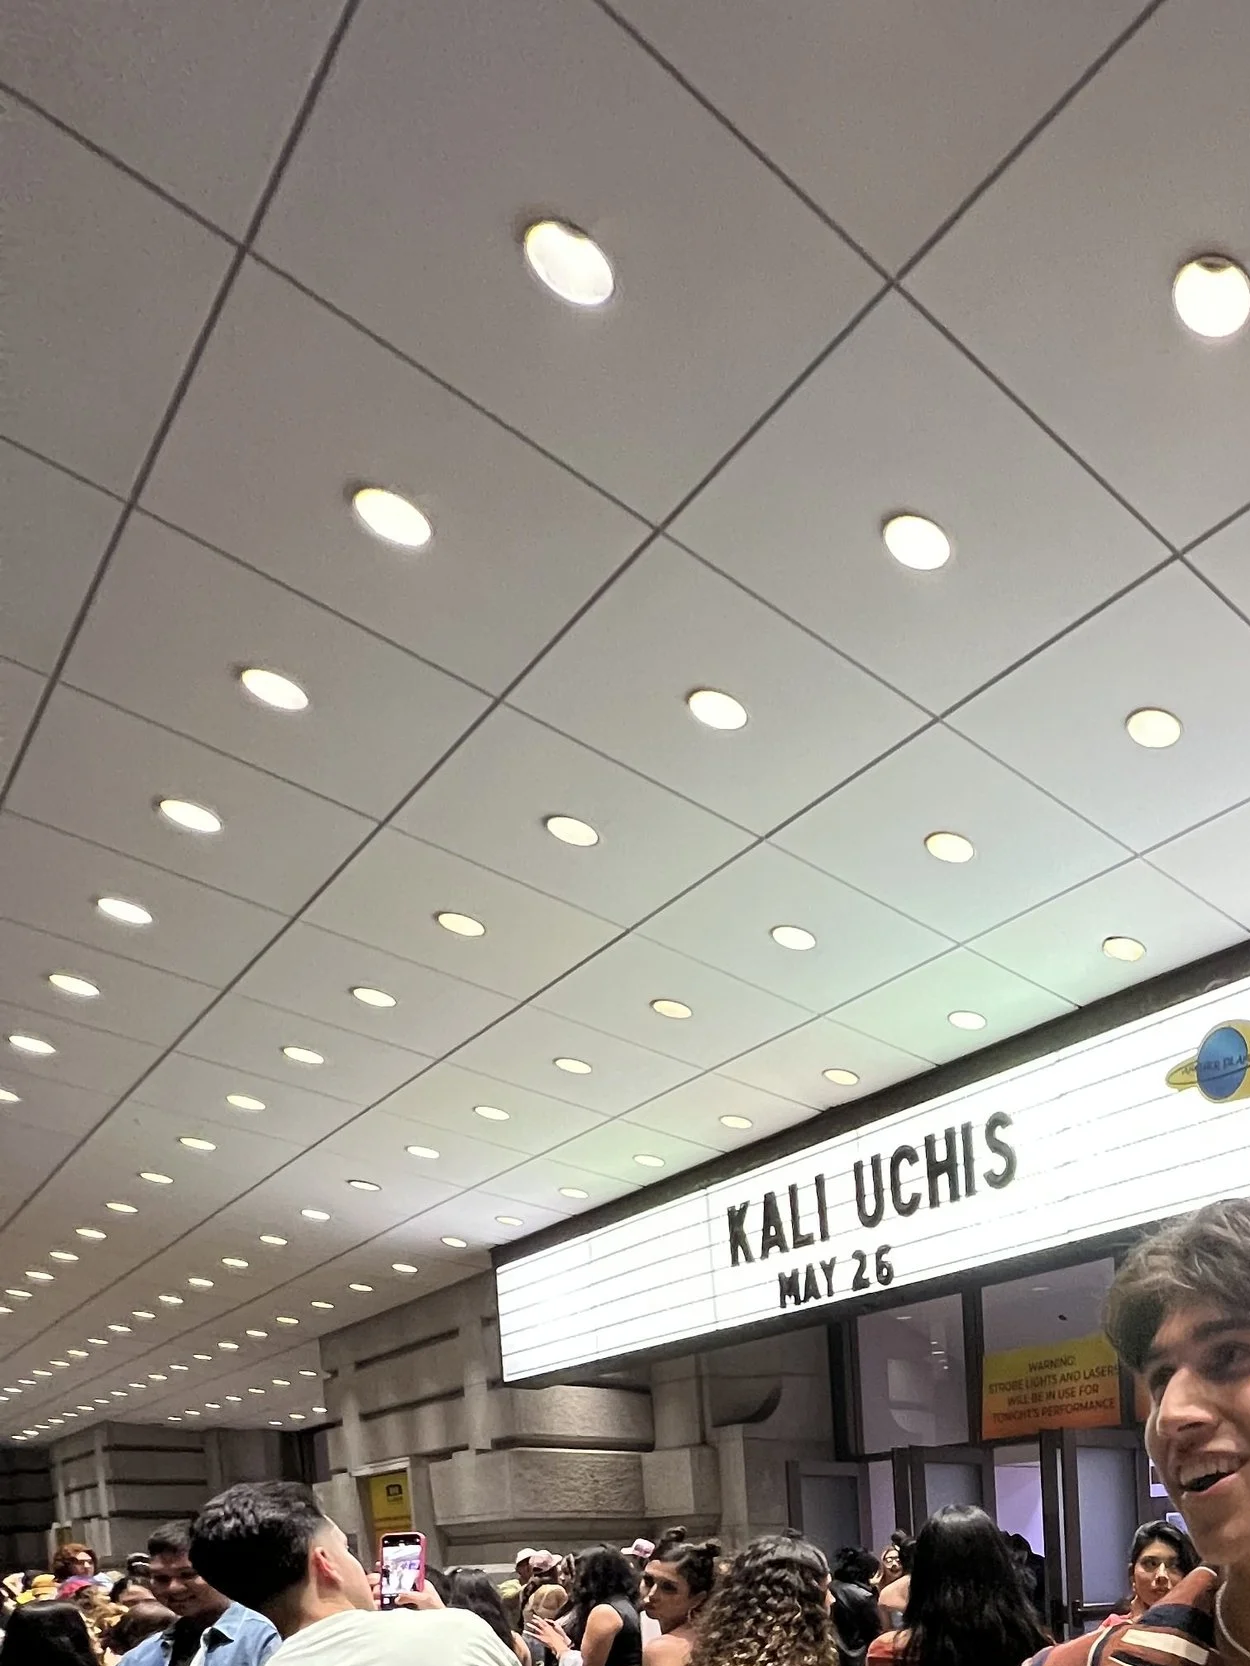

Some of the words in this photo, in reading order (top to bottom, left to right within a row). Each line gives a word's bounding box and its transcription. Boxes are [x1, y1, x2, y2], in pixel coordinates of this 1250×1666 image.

[727, 1173, 830, 1268] KALI
[853, 1111, 1018, 1229] UCHIS
[778, 1256, 837, 1309] MAY
[852, 1244, 896, 1292] 26
[988, 1378, 1025, 1395] STROBE
[1025, 1373, 1058, 1390] LIGHTS
[1059, 1369, 1081, 1386] AND
[1006, 1394, 1030, 1407] WILL
[1031, 1392, 1044, 1404] BE
[1045, 1390, 1056, 1402] IN
[1058, 1387, 1076, 1399] USE
[1078, 1383, 1100, 1396] FOR
[1041, 1397, 1116, 1418] PERFORMANCE
